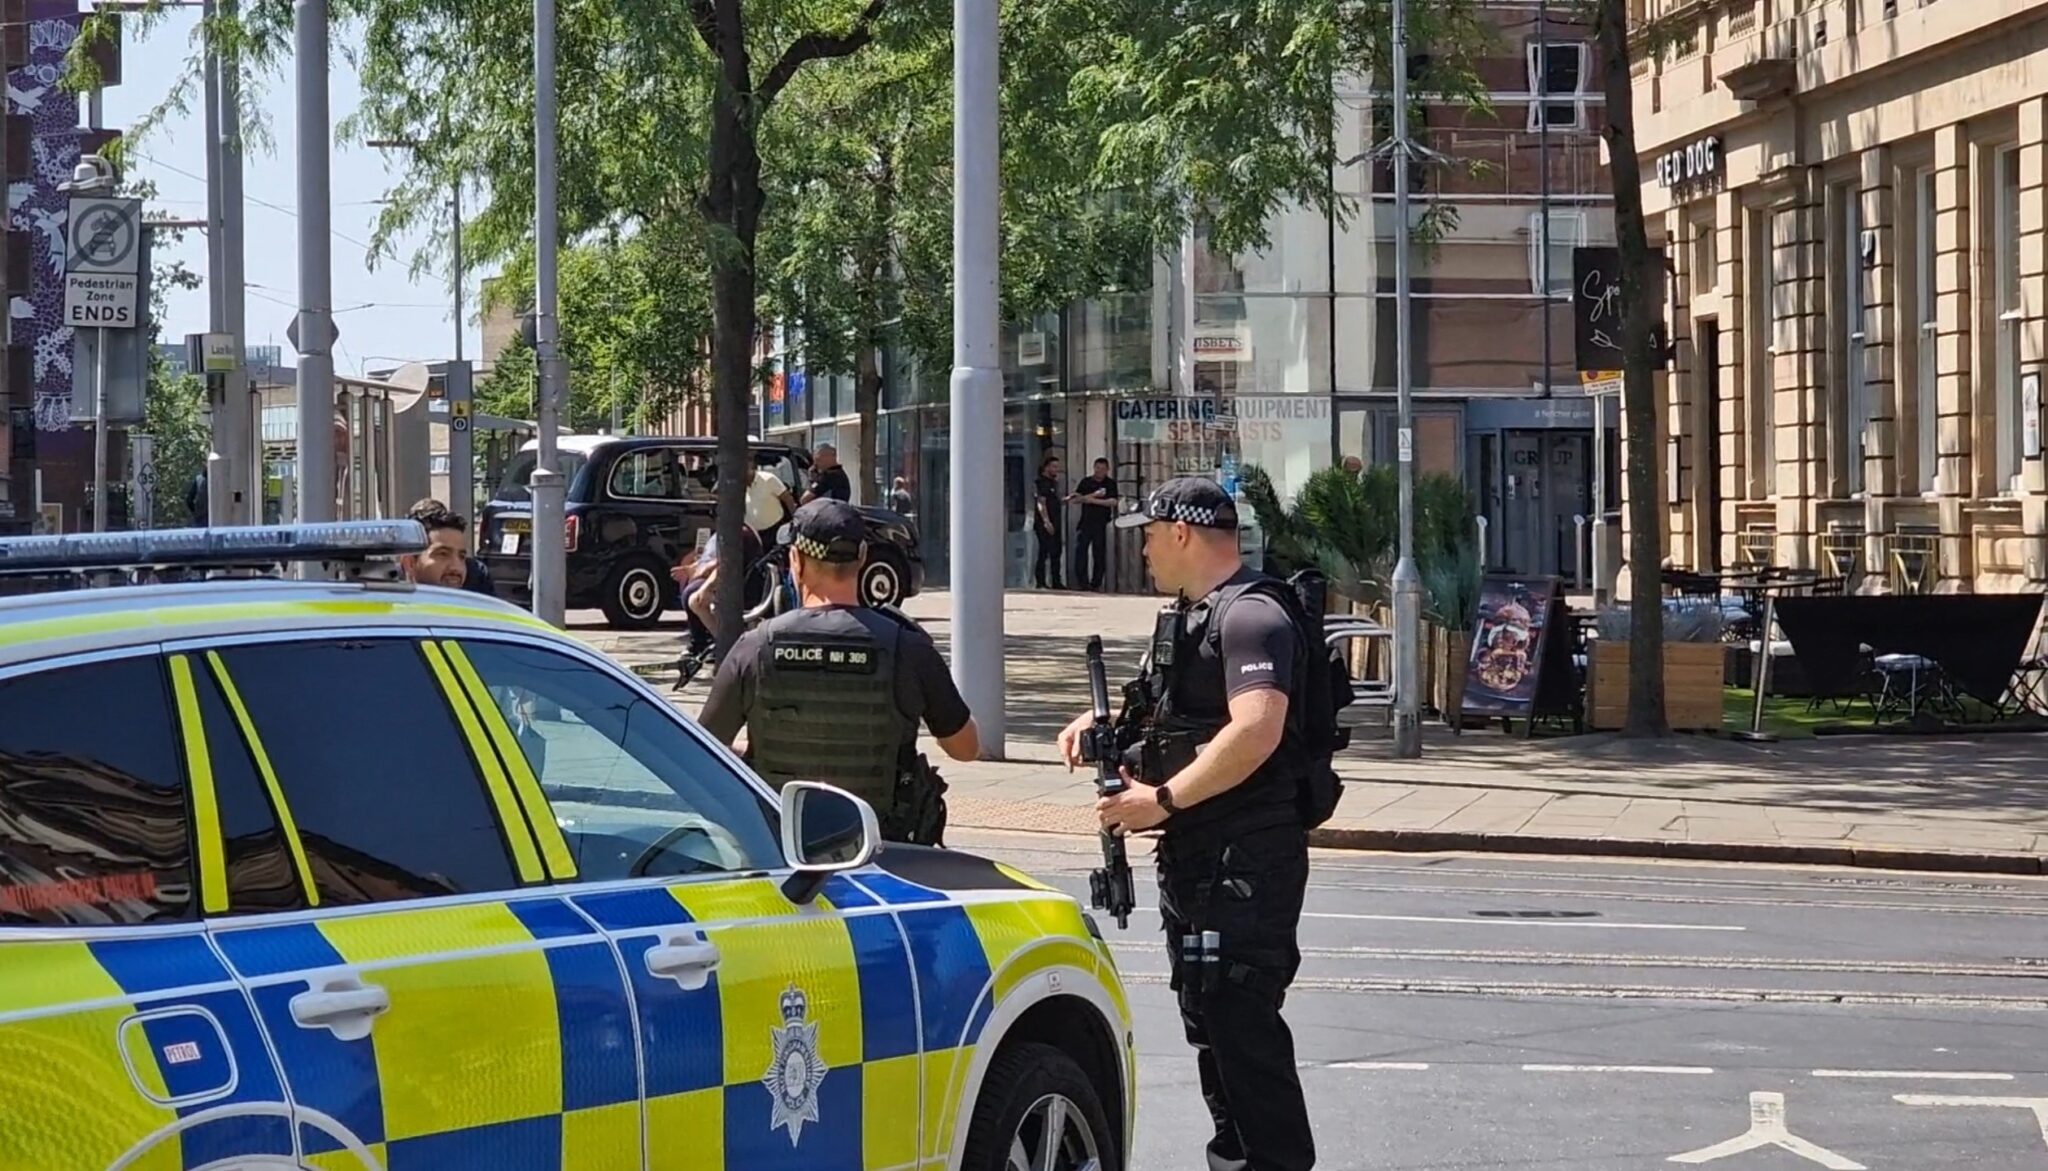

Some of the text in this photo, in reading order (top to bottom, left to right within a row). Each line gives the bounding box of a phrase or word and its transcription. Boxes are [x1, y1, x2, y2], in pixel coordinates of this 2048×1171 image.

[1656, 135, 1717, 188] RED DOG
[70, 278, 133, 290] Pedestrian
[86, 291, 115, 302] Zone
[72, 305, 128, 321] ENDS
[1118, 399, 1330, 420] CATERING EQUIPMENT
[1167, 421, 1283, 442] SPECISTS
[1514, 450, 1573, 466] GRUP
[775, 647, 823, 661] POLICE
[829, 651, 844, 663] NH
[1241, 661, 1274, 675] POLICE
[166, 1044, 198, 1062] PETROL
